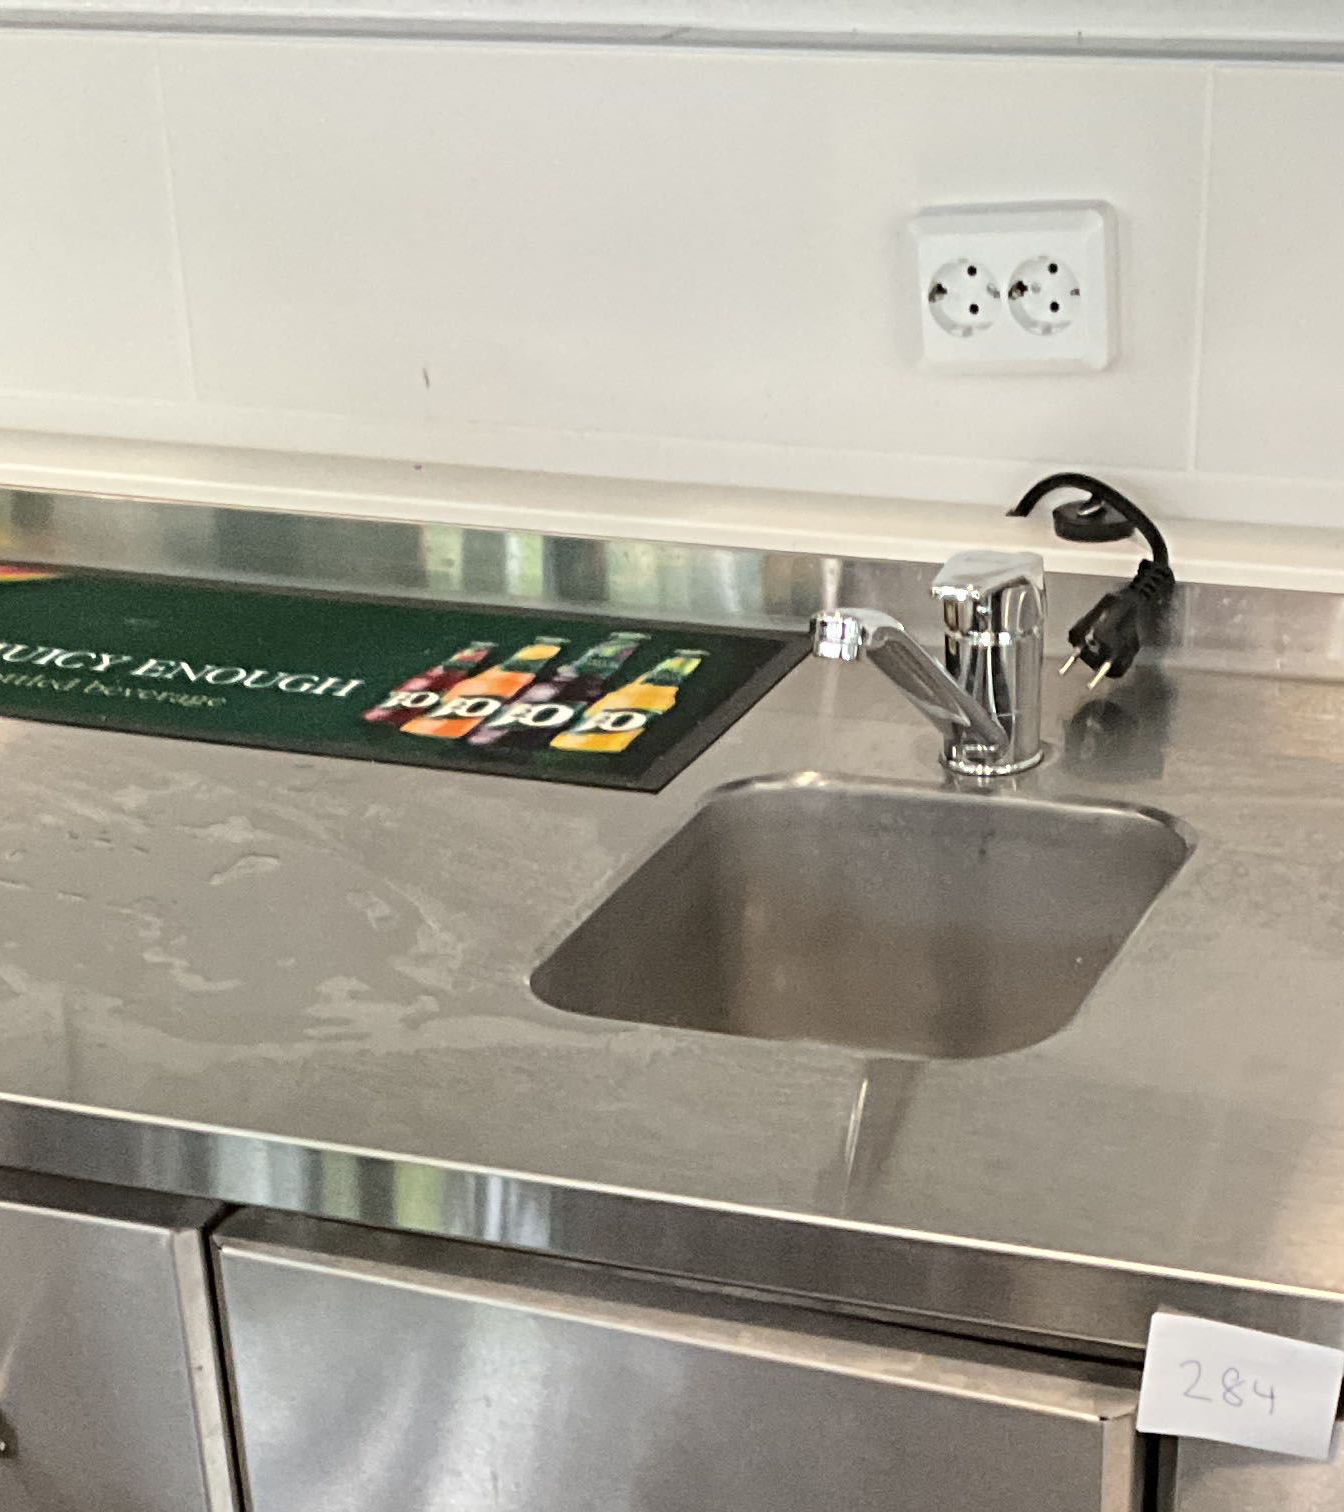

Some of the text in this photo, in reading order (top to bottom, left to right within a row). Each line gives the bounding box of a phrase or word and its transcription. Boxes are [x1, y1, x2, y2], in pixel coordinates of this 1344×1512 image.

[83, 679, 227, 708] beverage
[130, 658, 365, 698] ENOUGH
[1179, 1358, 1276, 1416] 284
